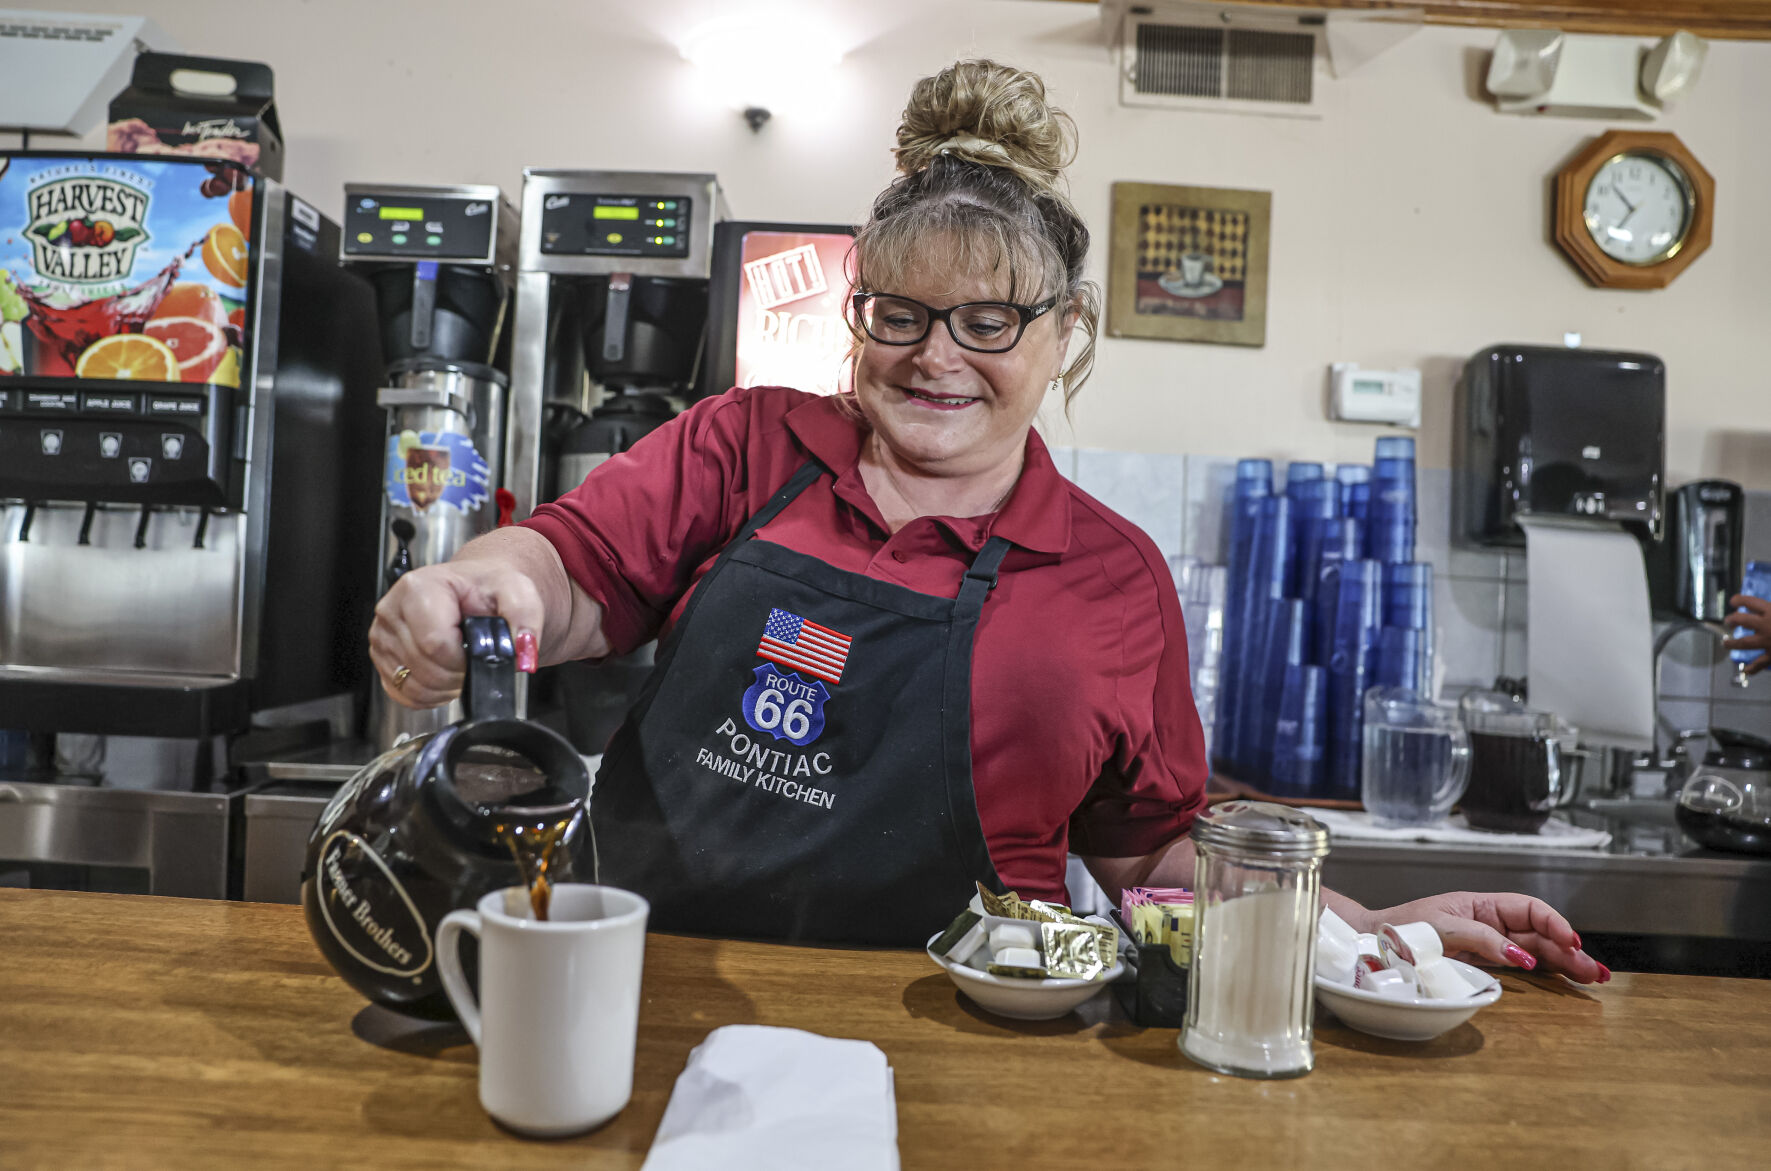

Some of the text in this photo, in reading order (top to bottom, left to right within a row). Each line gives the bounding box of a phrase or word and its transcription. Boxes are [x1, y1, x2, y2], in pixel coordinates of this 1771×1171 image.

[35, 184, 144, 223] HARVEST
[41, 244, 128, 279] VALLEY
[752, 250, 821, 306] HOT!
[432, 466, 466, 487] tea
[765, 673, 818, 702] ROUTE
[754, 688, 813, 740] 66
[715, 717, 833, 777] PONTIAC
[696, 748, 836, 810] FAMILY KITCHEN
[352, 899, 413, 966] Brothers
